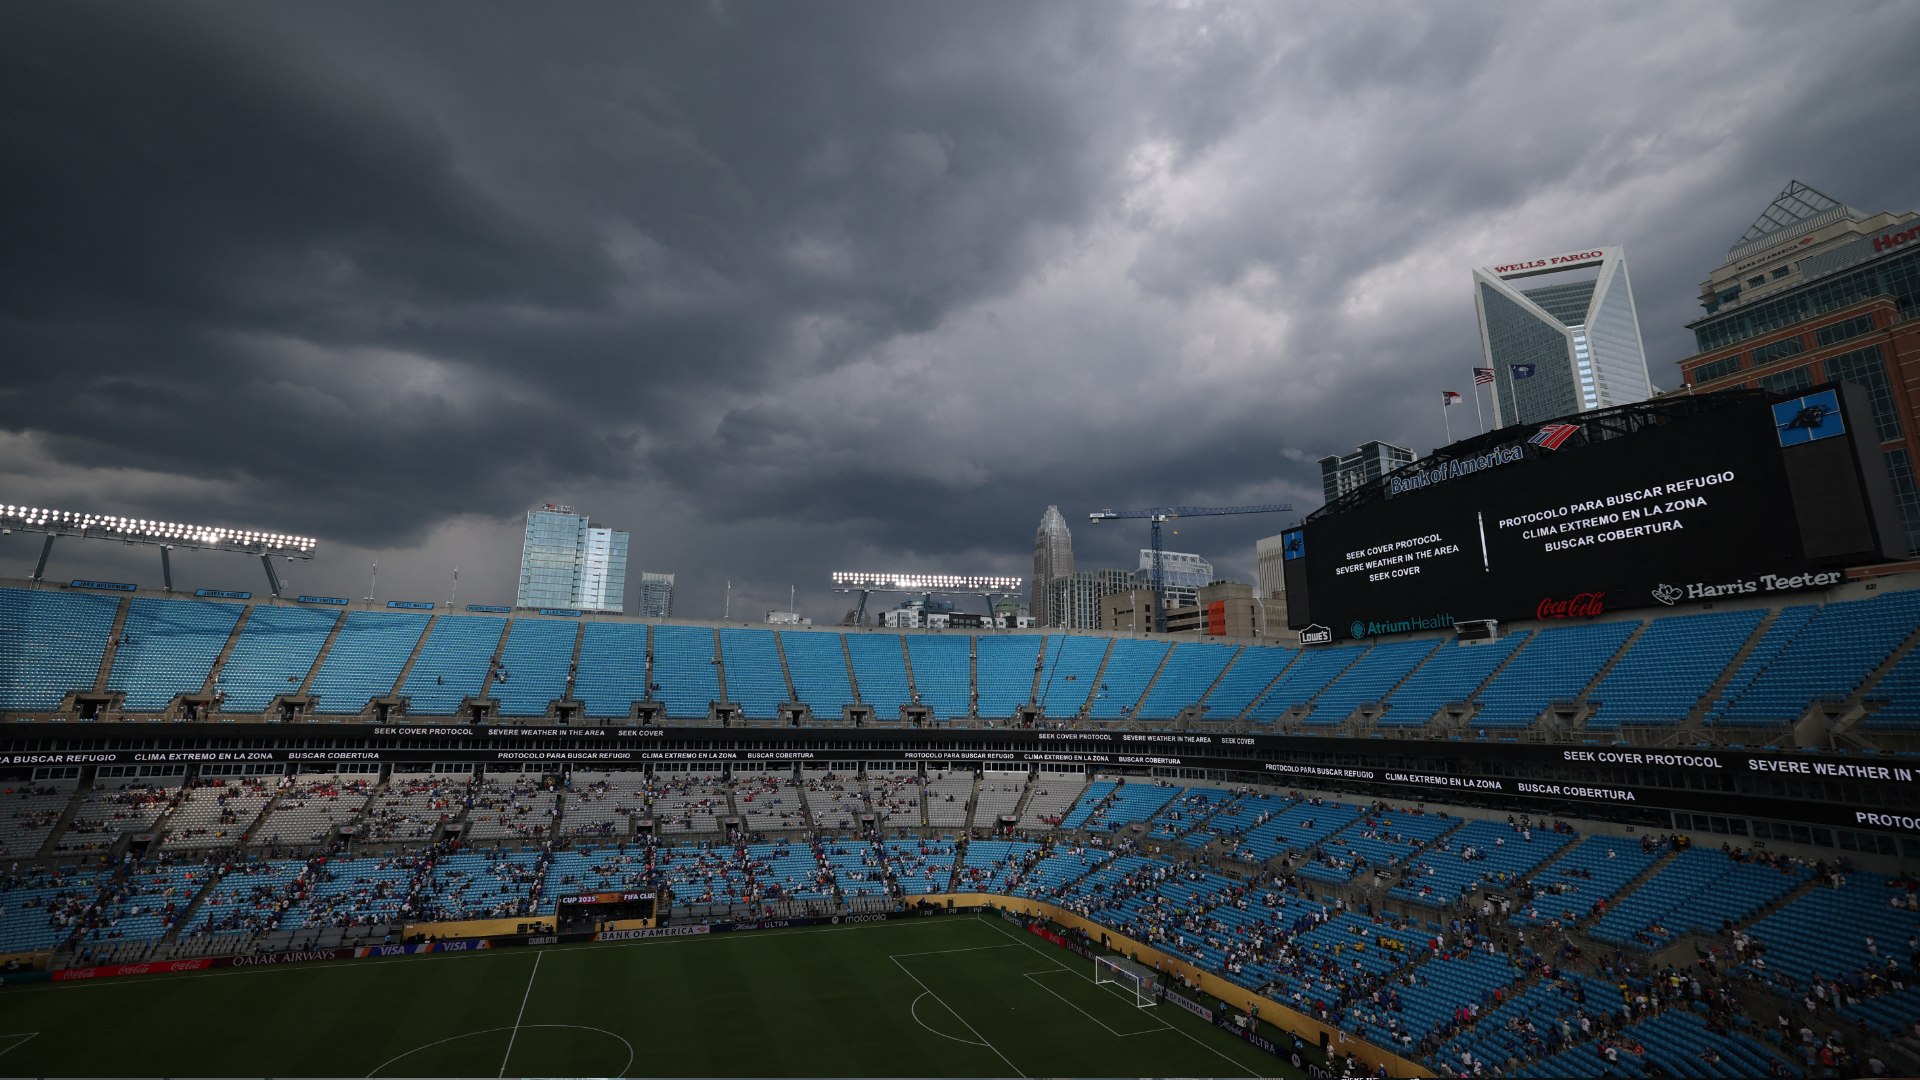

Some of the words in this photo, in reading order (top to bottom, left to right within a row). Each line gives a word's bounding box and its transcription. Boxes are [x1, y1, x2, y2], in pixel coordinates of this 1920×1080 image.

[1494, 260, 1546, 273] WELLS
[1550, 251, 1603, 264] FARGO
[1738, 261, 1756, 270] BANK
[1767, 245, 1798, 259] AMERICA
[1391, 469, 1430, 494] Bank
[1431, 462, 1448, 483] of
[1450, 445, 1524, 478] America
[1499, 507, 1567, 529] PROTOCOLO
[1570, 499, 1604, 514] PARA
[1606, 486, 1663, 507] BUSCAR
[1665, 471, 1735, 494] REFUGIO
[1522, 525, 1557, 540] CLIMA
[1560, 513, 1619, 533] EXTREMO
[1622, 509, 1641, 522] EN
[1644, 505, 1663, 517] LA
[1665, 496, 1707, 513] ZONA
[1545, 536, 1595, 552] BUSCAR
[1597, 519, 1683, 543] COBERTURA
[1346, 550, 1365, 560] SEEK
[1367, 543, 1394, 556] COVER
[1395, 533, 1442, 550] PROTOCOL
[1335, 563, 1364, 575] SEVERE
[1365, 556, 1403, 569] WEATHER
[1405, 553, 1413, 561] IN
[1415, 550, 1432, 560] THE
[1434, 544, 1459, 556] AREA
[1369, 571, 1390, 582] SEEK
[1392, 566, 1420, 578] COVER
[1686, 580, 1757, 599] Harris
[1760, 570, 1841, 590] Teeter
[1367, 619, 1411, 635] Atrium
[1411, 613, 1454, 629] Health
[1302, 631, 1329, 643] LOWE'S
[13, 755, 63, 763] BUSCAR
[66, 754, 116, 762] REFUGIO
[1563, 750, 1596, 762] SEEK
[1598, 752, 1642, 764] COVER
[1646, 754, 1722, 768] PROTOCOL
[1265, 764, 1299, 772] PROTOCOLO
[1300, 766, 1316, 774] PARA
[1317, 767, 1343, 776] BUSCAR
[1344, 770, 1373, 779] REFUGIO
[1748, 759, 1810, 774] SEVERE
[1812, 762, 1890, 780] WEATHER
[1894, 767, 1912, 781] IN
[1385, 773, 1408, 781] CLIMA
[1410, 774, 1448, 785] EXTREMO
[1450, 778, 1461, 786] EN
[1463, 779, 1475, 788] LA
[1476, 780, 1502, 790] ZONA
[1518, 782, 1560, 795] BUSCAR
[1563, 786, 1636, 800] COBERTURA
[764, 921, 789, 929] ULTRA
[844, 913, 887, 924] motorola
[528, 936, 558, 945] CHARLOTTE
[602, 930, 630, 940] BANK
[633, 930, 646, 938] OF
[648, 927, 694, 937] AMERICA
[379, 944, 405, 956] VISA
[442, 941, 467, 951] VISA
[232, 953, 277, 966] QATAR
[281, 950, 336, 963] AIRWAYS
[1170, 992, 1177, 1001] OF
[1178, 997, 1204, 1016] AMERICA
[1249, 1032, 1276, 1055] ULTRA
